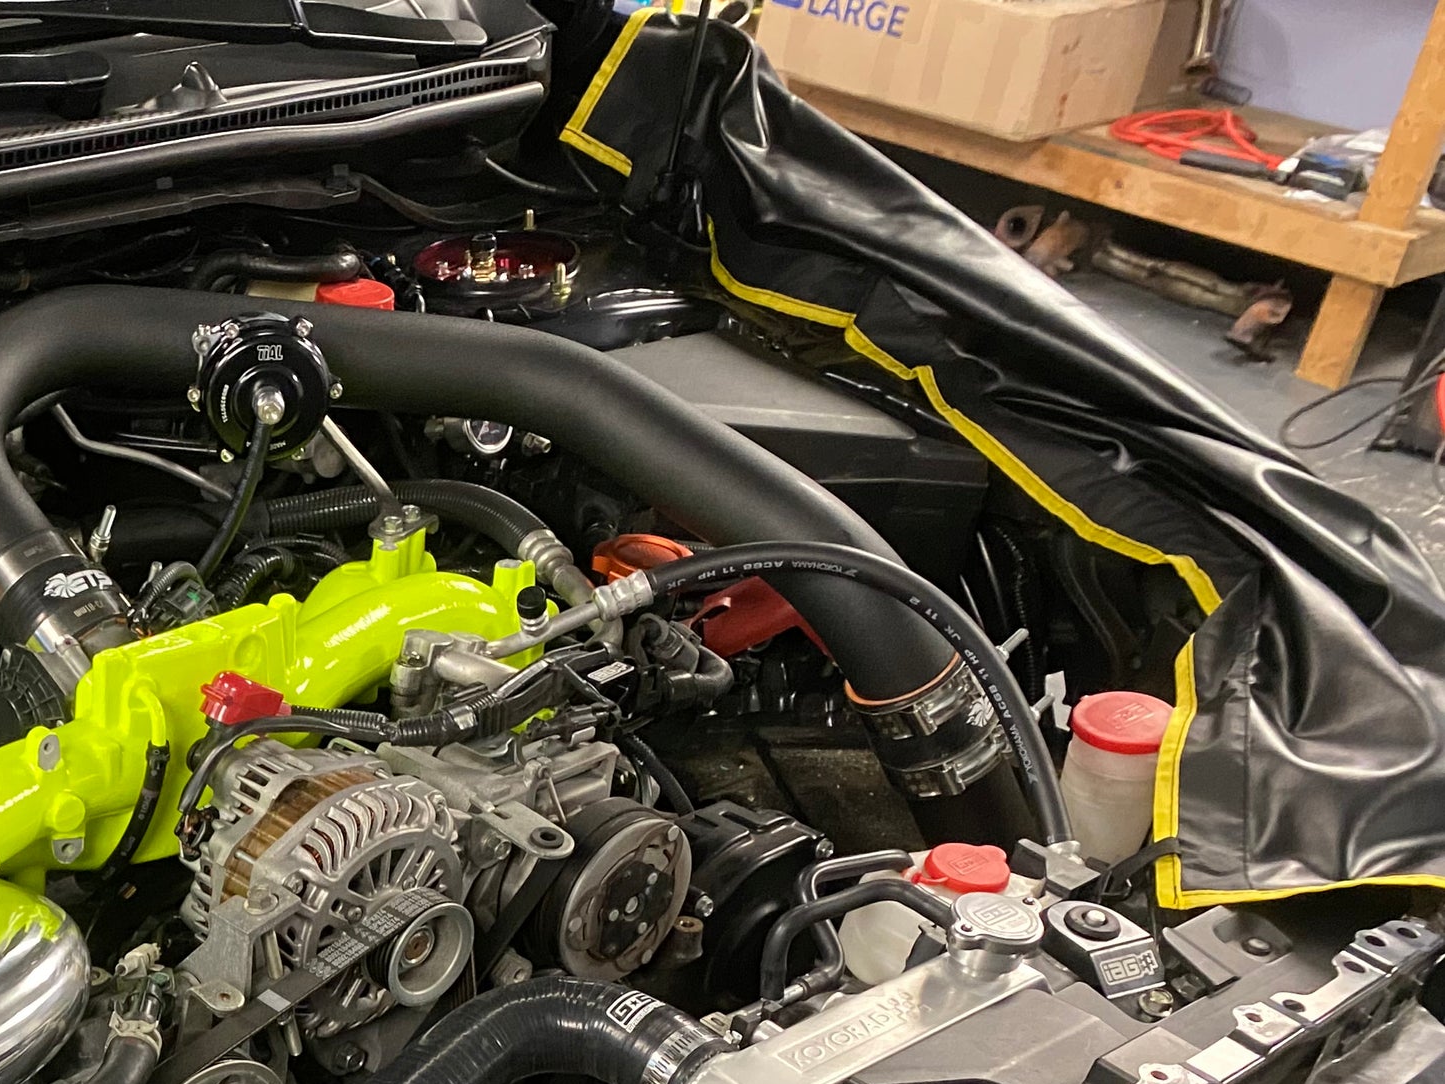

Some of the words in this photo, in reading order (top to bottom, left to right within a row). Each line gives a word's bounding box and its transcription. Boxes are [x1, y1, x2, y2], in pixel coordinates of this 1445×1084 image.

[698, 571, 716, 581] HP
[667, 578, 687, 591] JK
[944, 625, 961, 641] JK
[964, 649, 980, 665] HP
[779, 1011, 891, 1068] KOYORAD
